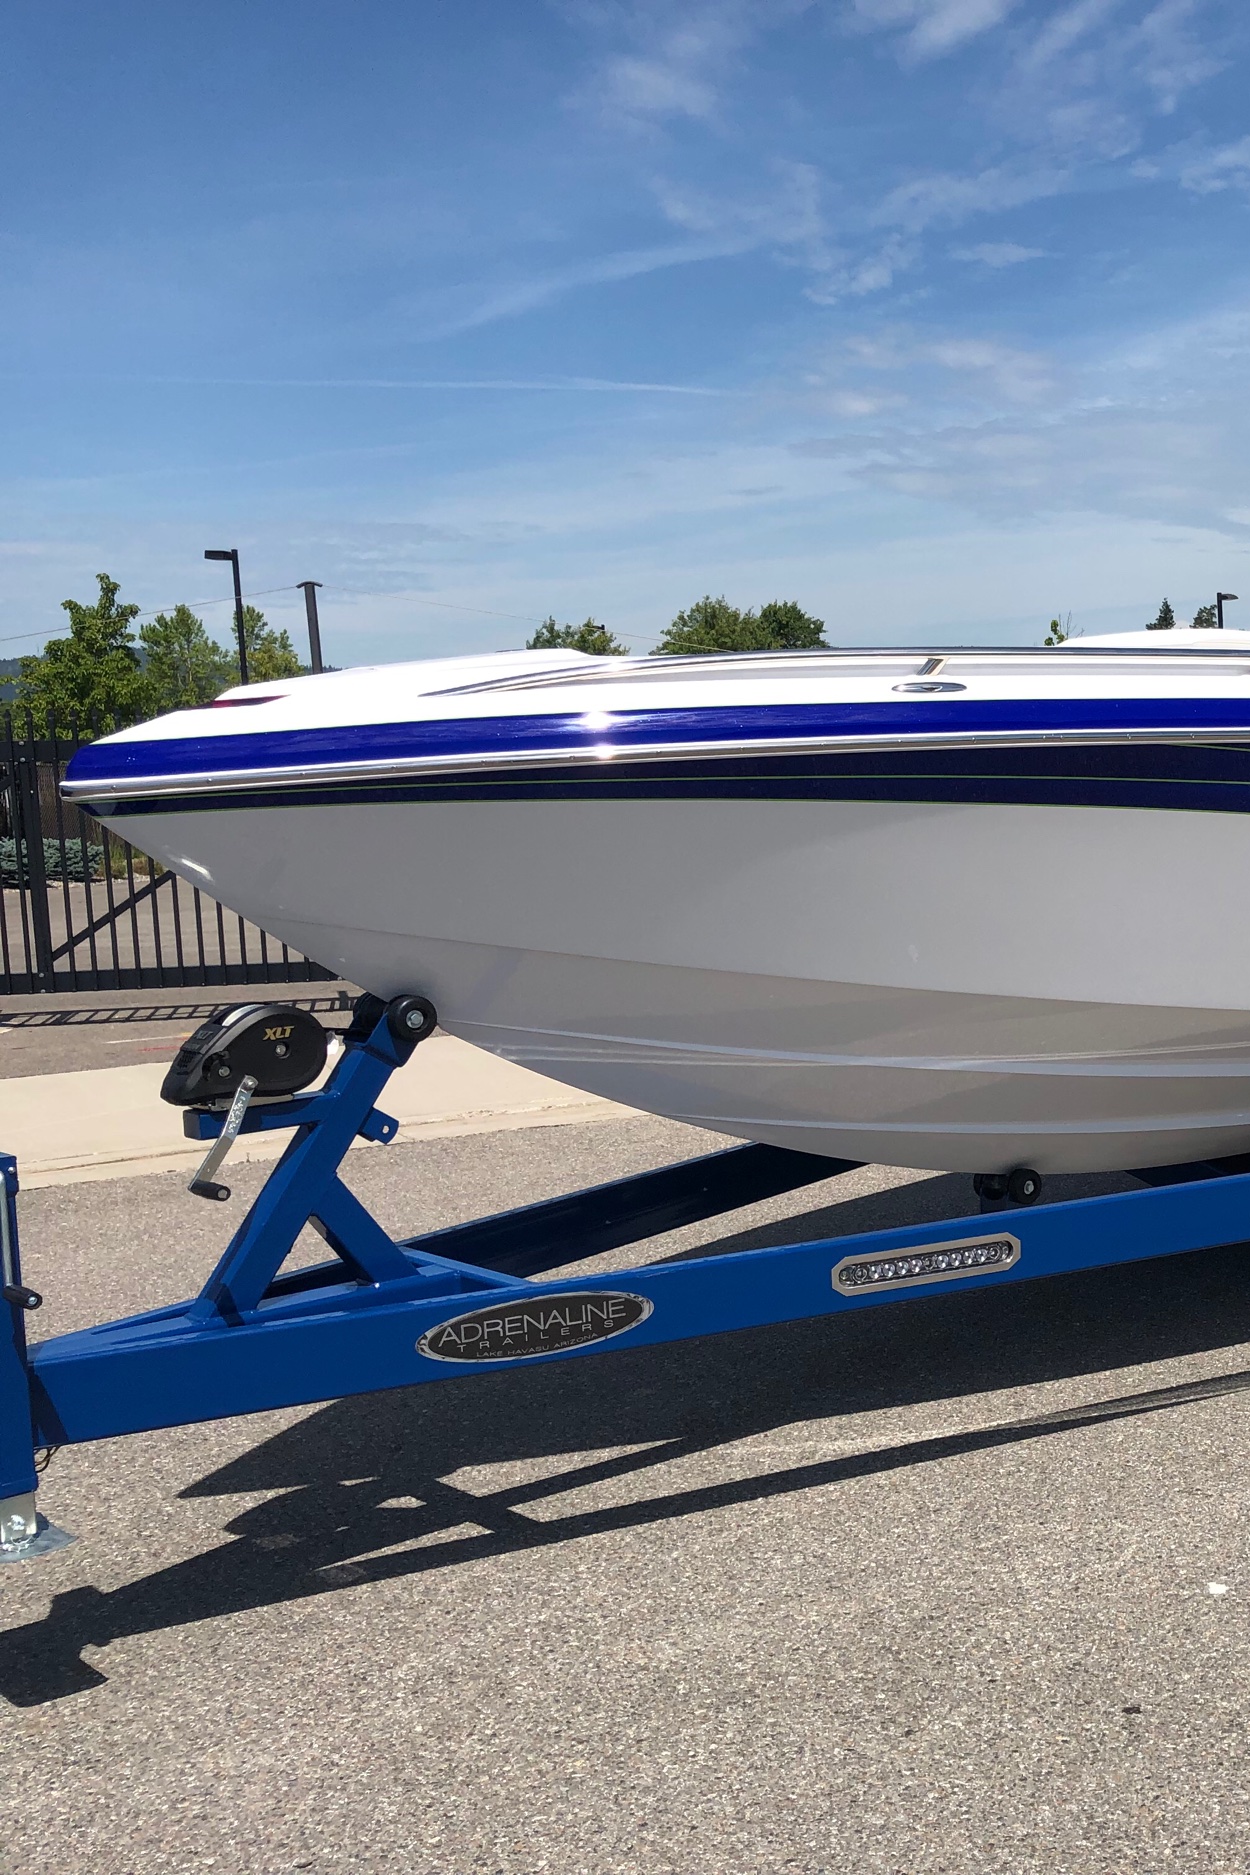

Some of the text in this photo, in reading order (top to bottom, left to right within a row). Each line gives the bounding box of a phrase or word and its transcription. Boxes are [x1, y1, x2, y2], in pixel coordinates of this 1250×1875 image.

[262, 1025, 295, 1041] XLT
[438, 1298, 627, 1348] ADRENALINE
[457, 1319, 614, 1353] TRAILERS
[476, 1332, 598, 1358] LAKE HAVASU ARIZONA
